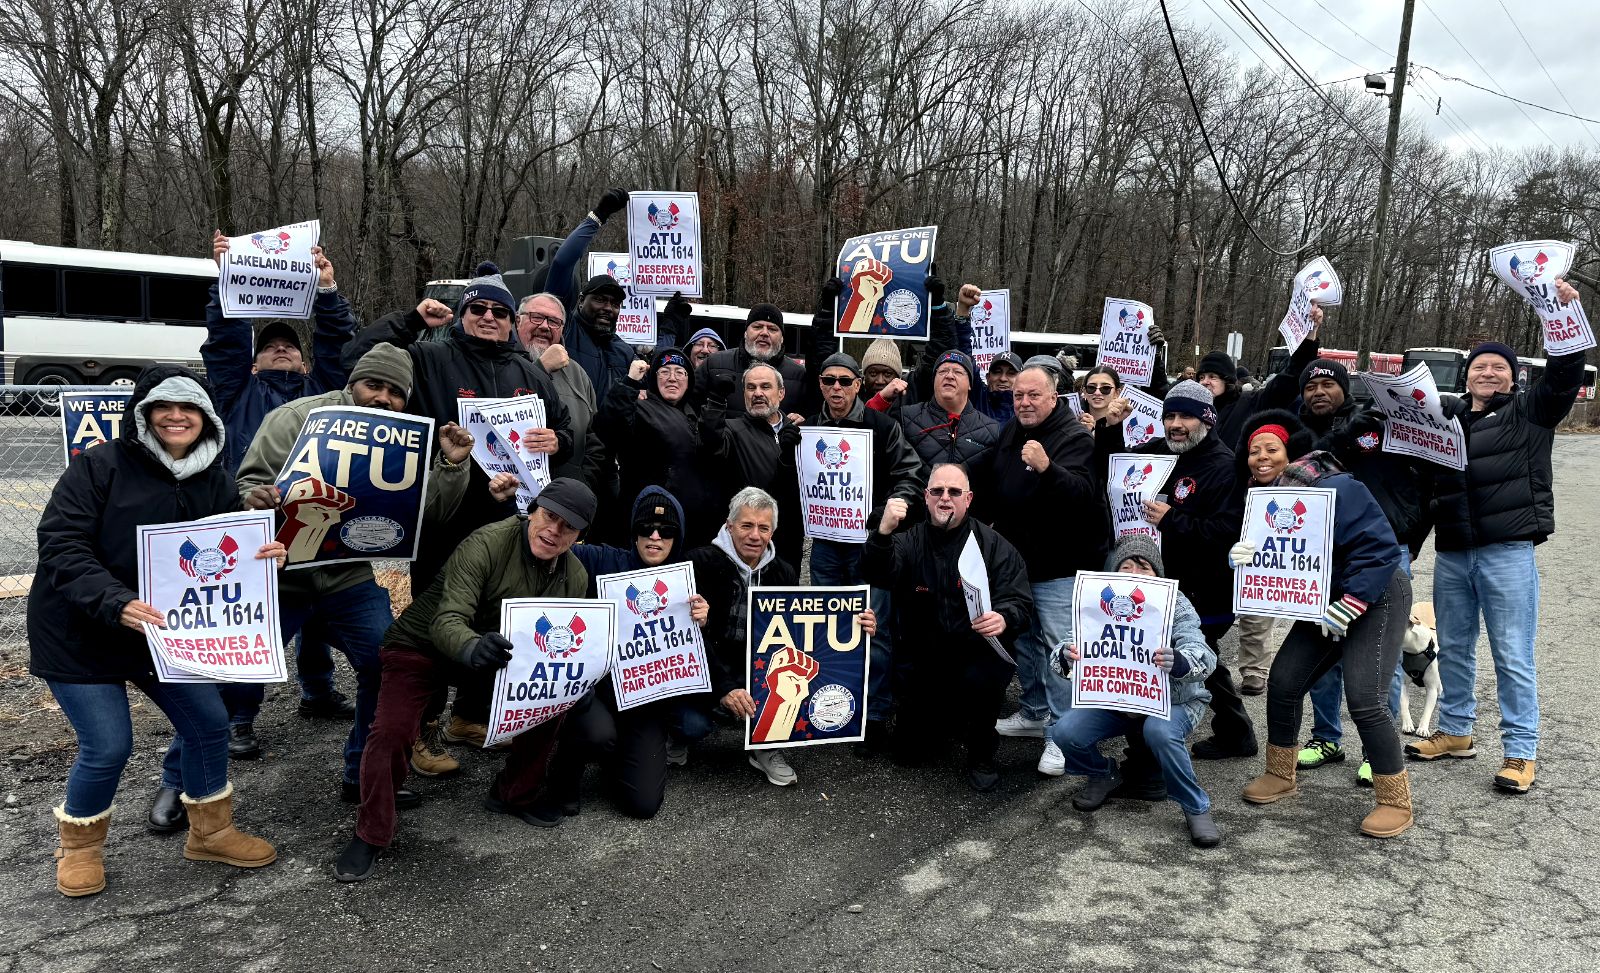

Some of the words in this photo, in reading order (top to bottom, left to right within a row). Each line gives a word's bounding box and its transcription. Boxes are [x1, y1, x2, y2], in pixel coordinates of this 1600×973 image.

[649, 233, 682, 246] ATU
[851, 237, 873, 245] WE
[874, 234, 901, 242] ARE
[902, 232, 930, 240] ONE
[637, 246, 669, 259] LOCAL
[671, 247, 694, 260] 1614
[845, 239, 929, 265] ATU
[230, 254, 288, 271] LAKELAND
[291, 261, 312, 274] BUS
[638, 265, 685, 275] DESERVES
[687, 265, 694, 275] A
[230, 274, 247, 286] NO
[249, 277, 307, 292] CONTRACT
[636, 275, 654, 285] FAIR
[656, 275, 696, 286] CONTRACT
[239, 294, 253, 305] NO
[257, 295, 294, 307] WORK!!
[629, 297, 650, 310] 1614
[619, 315, 641, 324] RVES
[643, 316, 649, 324] A
[1567, 316, 1576, 326] A
[617, 324, 651, 334] ONTRACT
[985, 336, 1004, 349] 1614
[1115, 332, 1143, 344] ATU
[1104, 341, 1129, 354] LOCAL
[1132, 345, 1150, 357] 1614
[1103, 356, 1140, 368] DESERVES
[1142, 361, 1147, 369] A
[1318, 369, 1335, 377] ATU
[68, 401, 95, 412] WE
[98, 401, 126, 412] ARE
[1129, 398, 1139, 410] TU
[1138, 404, 1158, 420] LOCAL
[487, 413, 514, 426] OCAL
[515, 409, 534, 422] 1614
[1387, 409, 1425, 426] LOCAL
[72, 414, 124, 445] AT
[305, 419, 330, 436] WE
[327, 419, 370, 440] ARE
[373, 425, 422, 449] ONE
[1392, 422, 1444, 444] DESERVES
[1447, 438, 1454, 447] A
[1392, 430, 1410, 443] FAIR
[1412, 436, 1457, 457] CONTRACT
[280, 438, 420, 492] ATU
[817, 472, 852, 487] ATU
[807, 485, 836, 501] LOCAL
[839, 487, 864, 502] 1614
[1123, 492, 1142, 508] ATU
[809, 504, 853, 518] DESERVES
[856, 508, 863, 519] A
[1117, 507, 1139, 523] LOCAL
[808, 515, 824, 526] FAIR
[825, 517, 865, 530] CONTRACT
[1262, 537, 1307, 554] ATU
[1291, 554, 1321, 573] 1614
[1245, 575, 1307, 591] DESERVES
[1310, 580, 1319, 592] A
[180, 583, 242, 608] ATU
[1242, 587, 1264, 600] FAIR
[1267, 589, 1321, 606] CONTRACT
[757, 599, 786, 612] WE
[790, 599, 824, 612] ARE
[828, 598, 863, 612] ONE
[222, 602, 265, 627] 1614
[633, 616, 676, 641] ATU
[756, 615, 863, 654] ATU
[1101, 624, 1145, 646] ATU
[164, 635, 249, 652] DESERVES
[254, 634, 266, 649] A
[618, 637, 661, 662] LOCAL
[664, 628, 694, 650] 1614
[1084, 641, 1127, 660] LOCAL
[167, 648, 197, 663] FAIR
[198, 650, 271, 666] CONTRACT
[529, 662, 585, 682] ATU
[623, 654, 685, 680] DESERVES
[688, 652, 697, 664] A
[622, 678, 646, 695] FAIR
[648, 664, 700, 687] CONTRACT
[1084, 666, 1148, 684] DESERVES
[1151, 675, 1160, 687] A
[507, 682, 558, 702] LOCAL
[1081, 679, 1104, 692] FAIR
[1107, 681, 1162, 701] CONTRACT
[498, 721, 525, 735] FAIR
